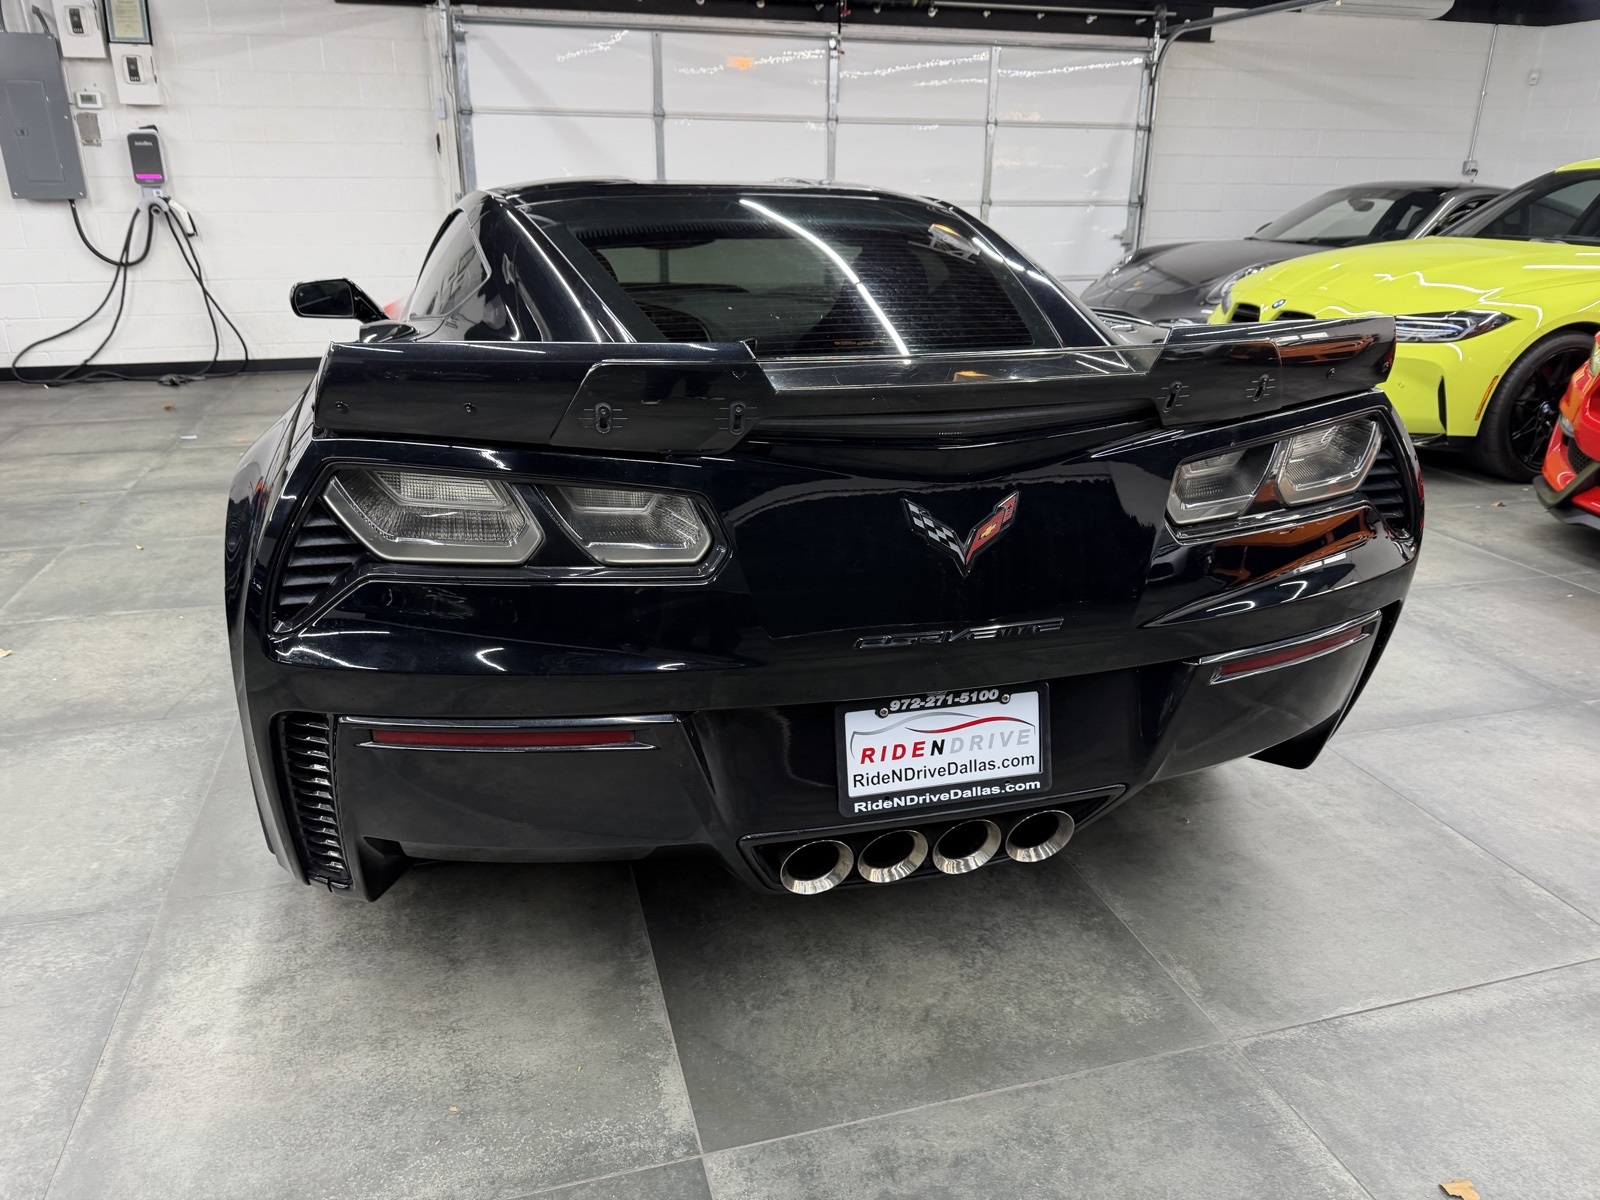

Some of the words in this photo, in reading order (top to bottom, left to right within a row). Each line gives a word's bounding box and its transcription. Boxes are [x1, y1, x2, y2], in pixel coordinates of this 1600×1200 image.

[889, 688, 1000, 711] 972-271-5100
[853, 754, 1035, 788] RideNDriveDallas.com
[854, 780, 1041, 813] RideNDriveDallas.com
